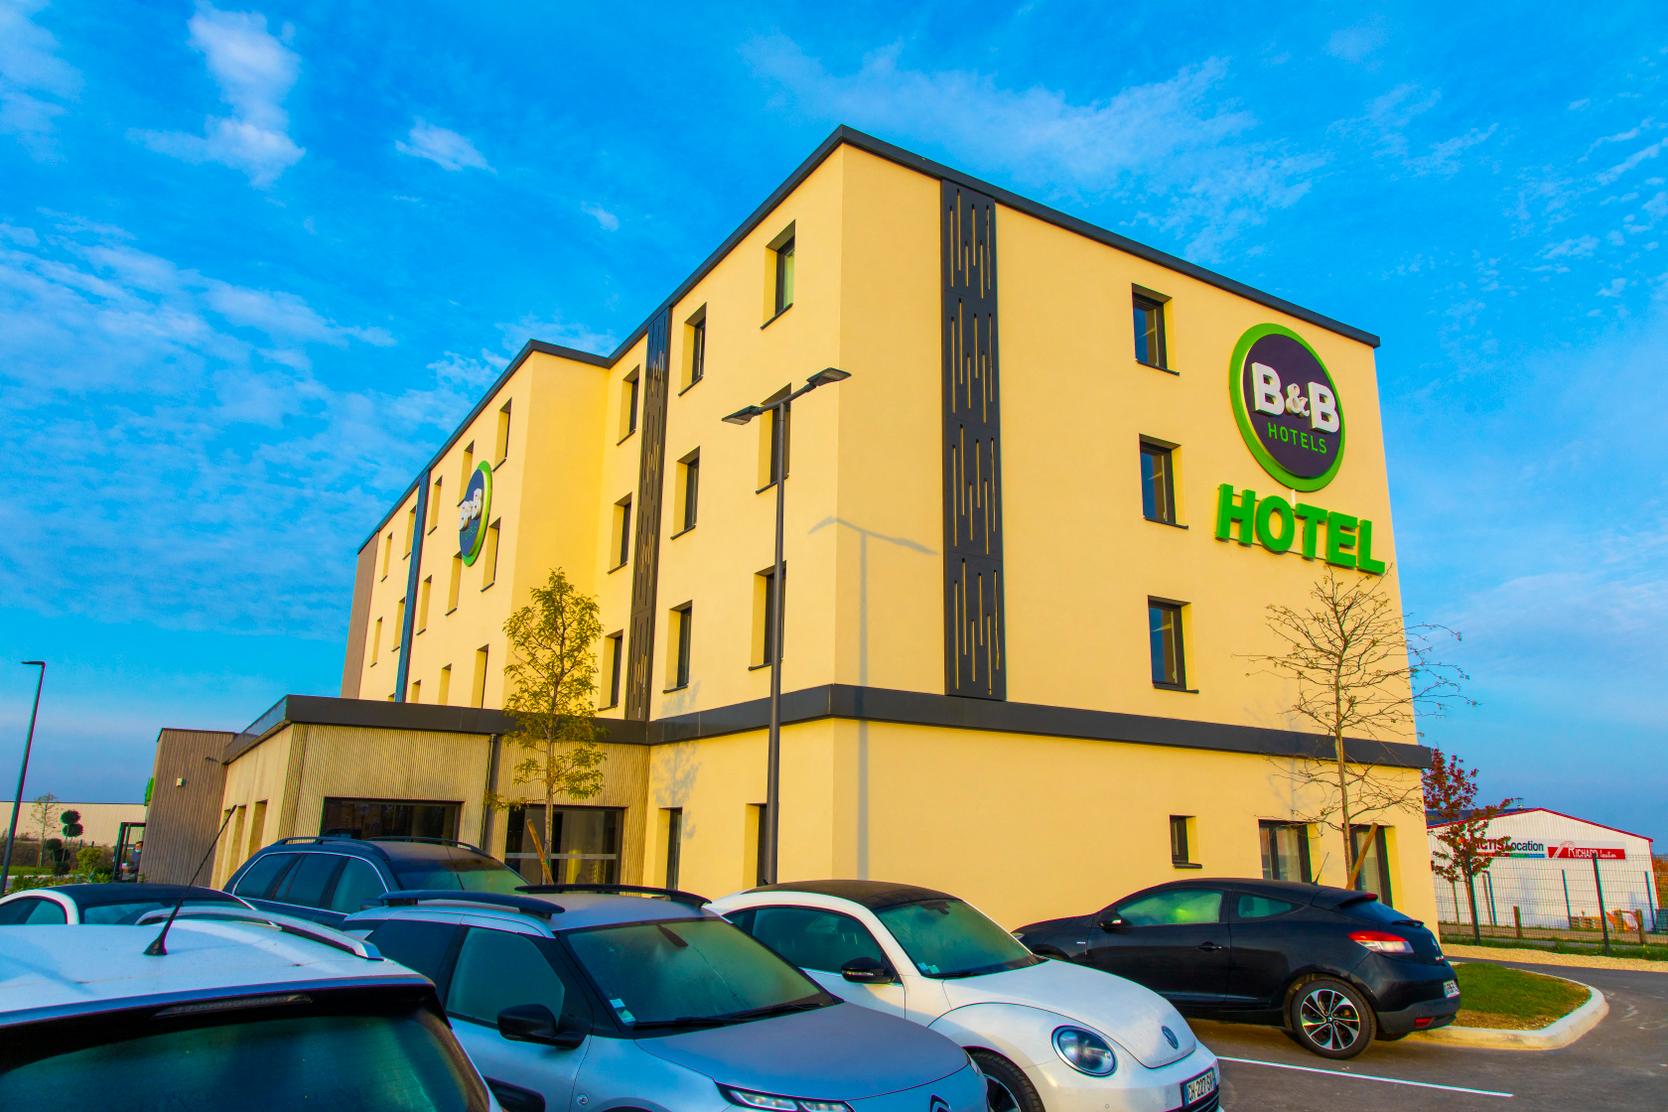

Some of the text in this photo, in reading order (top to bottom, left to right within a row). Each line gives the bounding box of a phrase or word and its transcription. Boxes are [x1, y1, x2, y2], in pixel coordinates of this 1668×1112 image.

[1252, 361, 1340, 433] B&B
[1267, 422, 1327, 454] HOTELS
[1216, 483, 1385, 574] HOTEL
